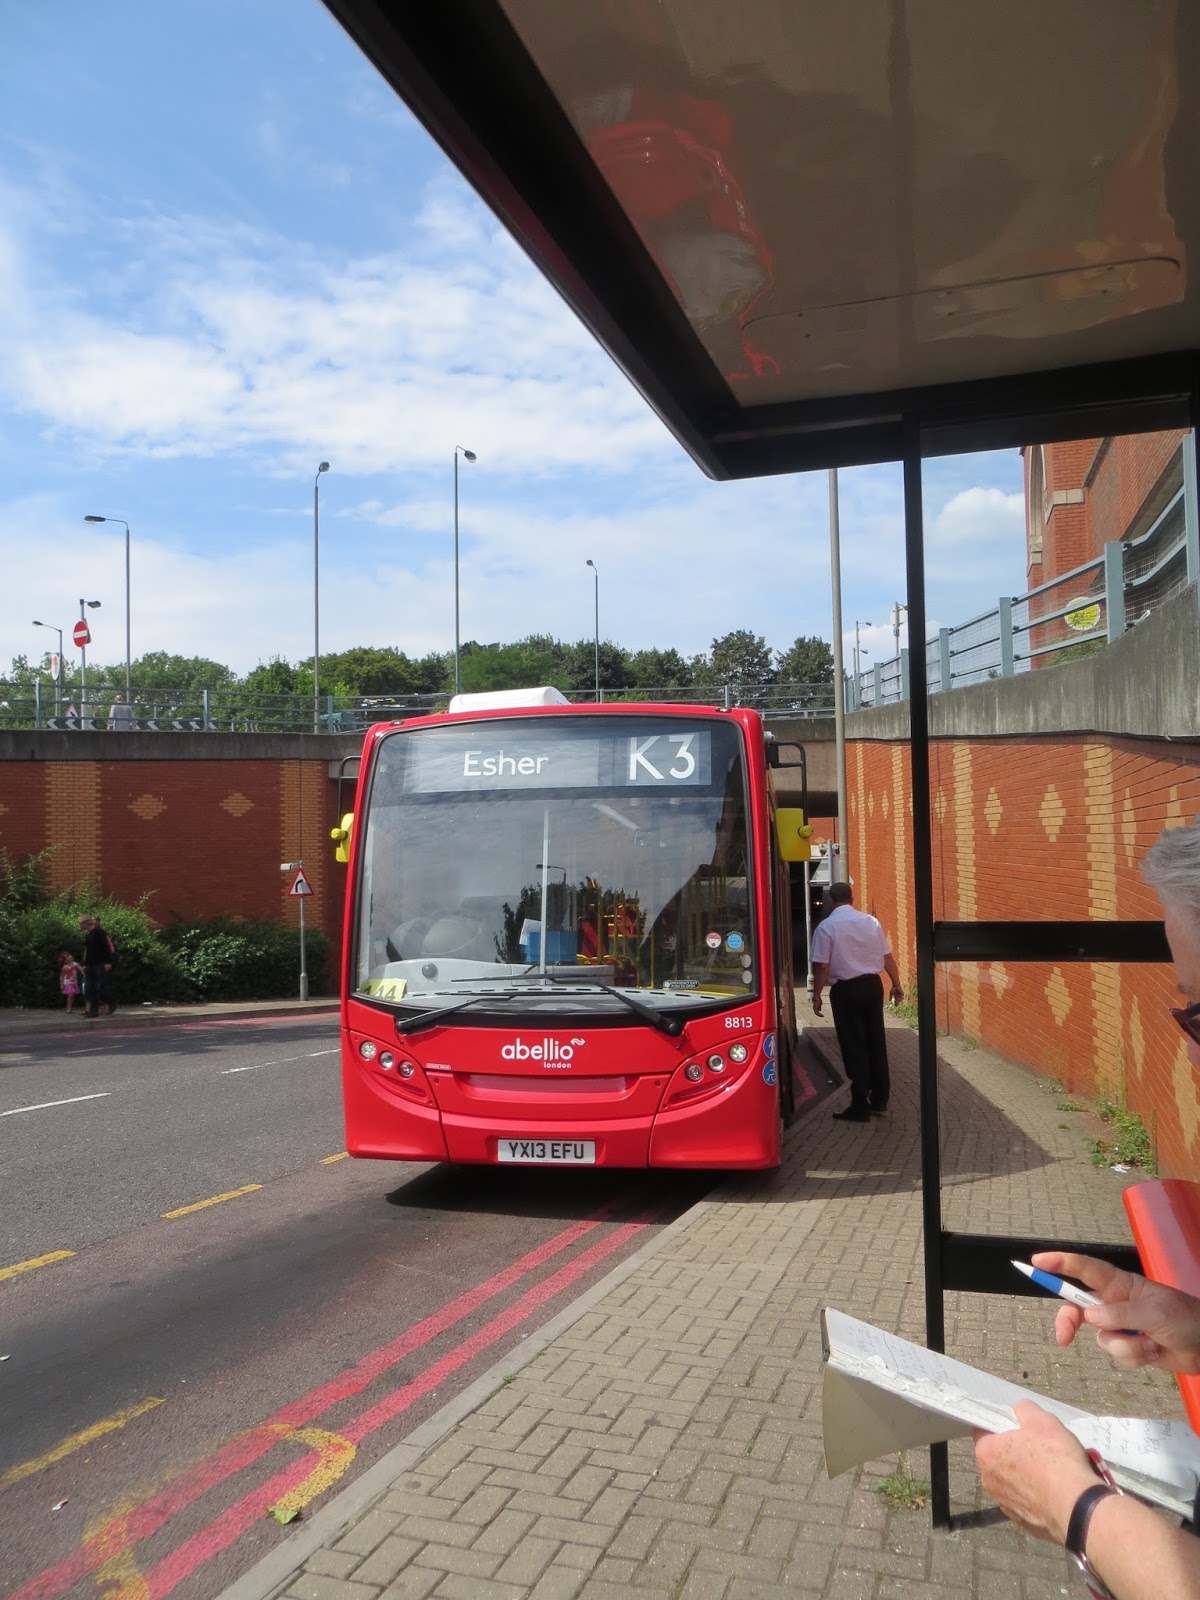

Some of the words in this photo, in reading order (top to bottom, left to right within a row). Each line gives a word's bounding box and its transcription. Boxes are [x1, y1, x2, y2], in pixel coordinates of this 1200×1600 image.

[463, 749, 549, 776] Esher
[629, 734, 696, 781] K3
[724, 1016, 753, 1029] 8813
[501, 1037, 574, 1061] abellio
[543, 1061, 572, 1069] london
[508, 1142, 546, 1158] YX13
[551, 1143, 584, 1159] EFU
